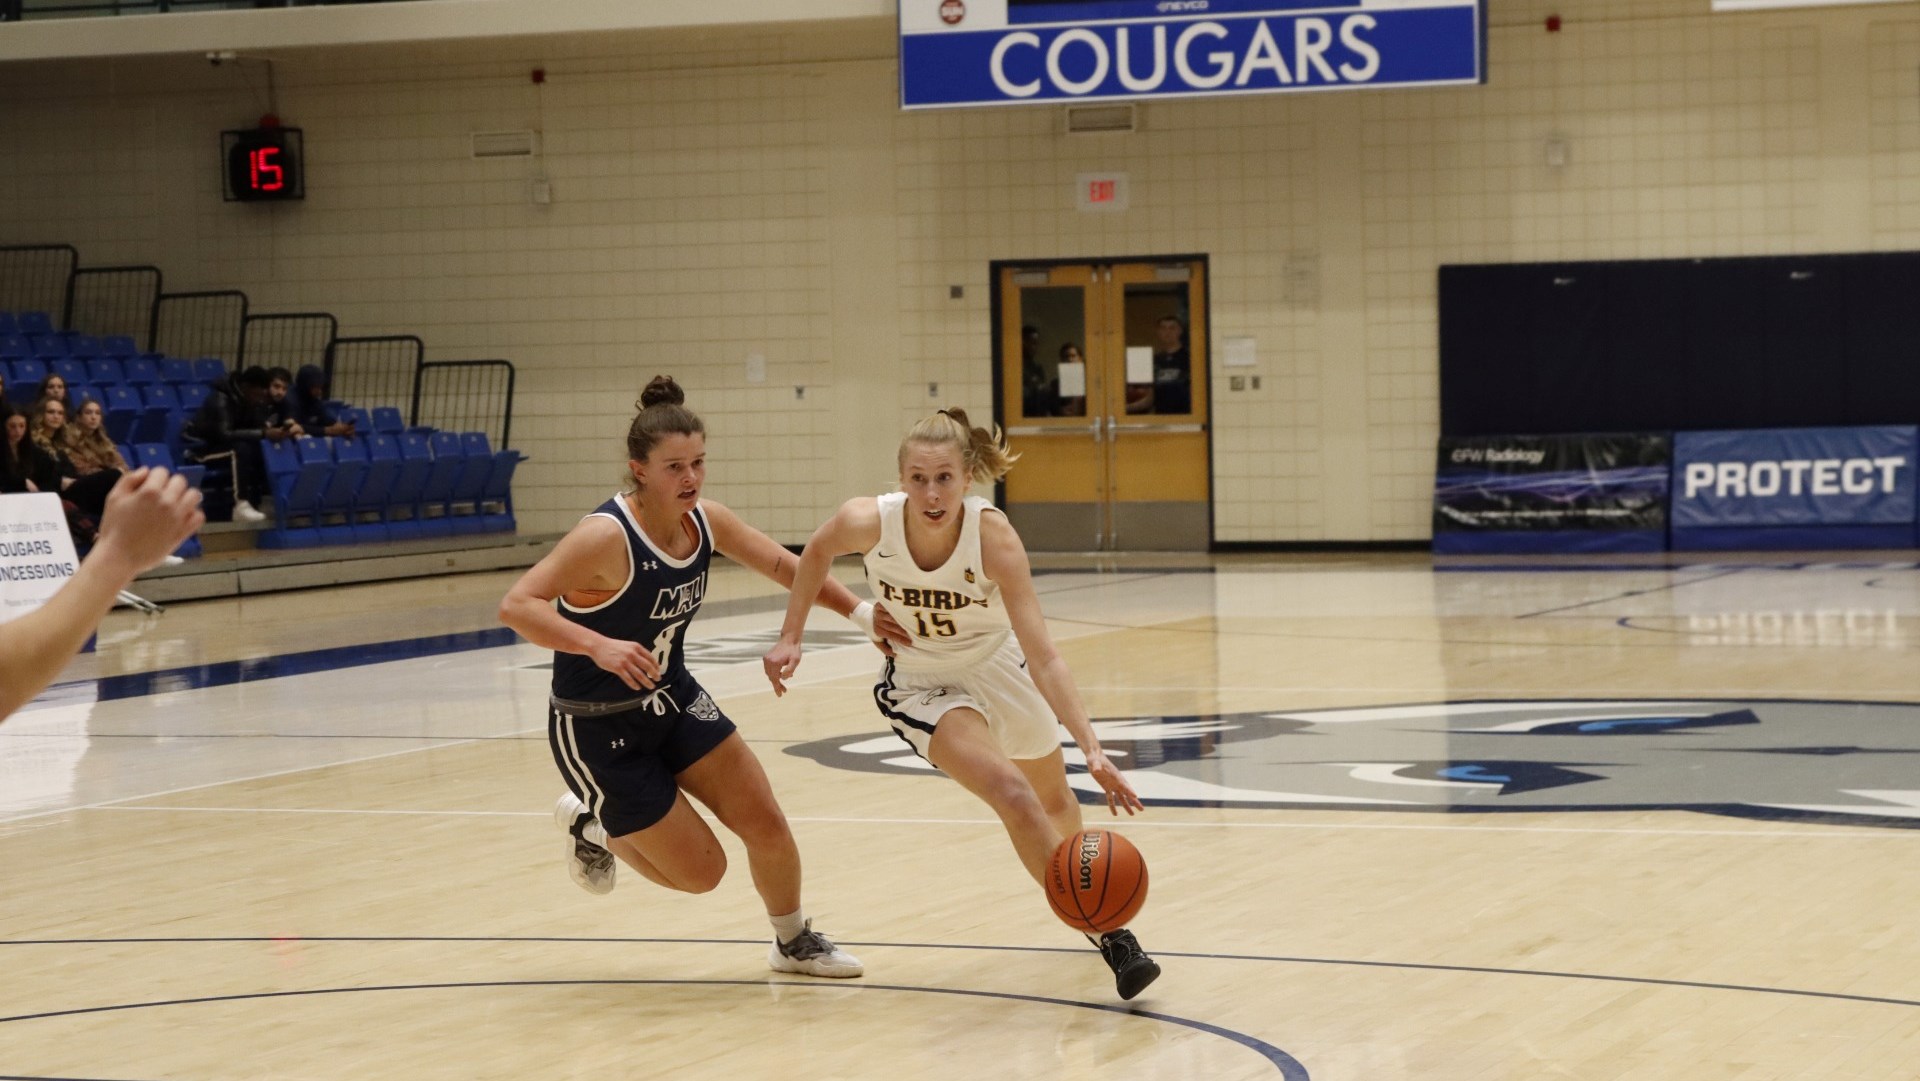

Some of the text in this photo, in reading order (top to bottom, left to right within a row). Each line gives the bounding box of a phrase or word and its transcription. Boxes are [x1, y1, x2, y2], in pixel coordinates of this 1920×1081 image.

[990, 14, 1381, 98] COUGARS
[249, 147, 283, 191] 15
[1088, 180, 1115, 202] EXIT
[1486, 447, 1546, 465] Radiology
[1685, 457, 1906, 498] PROTECT
[0, 540, 52, 557] OUGARS
[0, 562, 74, 582] NCESSIONS
[913, 611, 957, 638] 15
[646, 620, 686, 679] 8
[1080, 831, 1101, 891] Wilson
